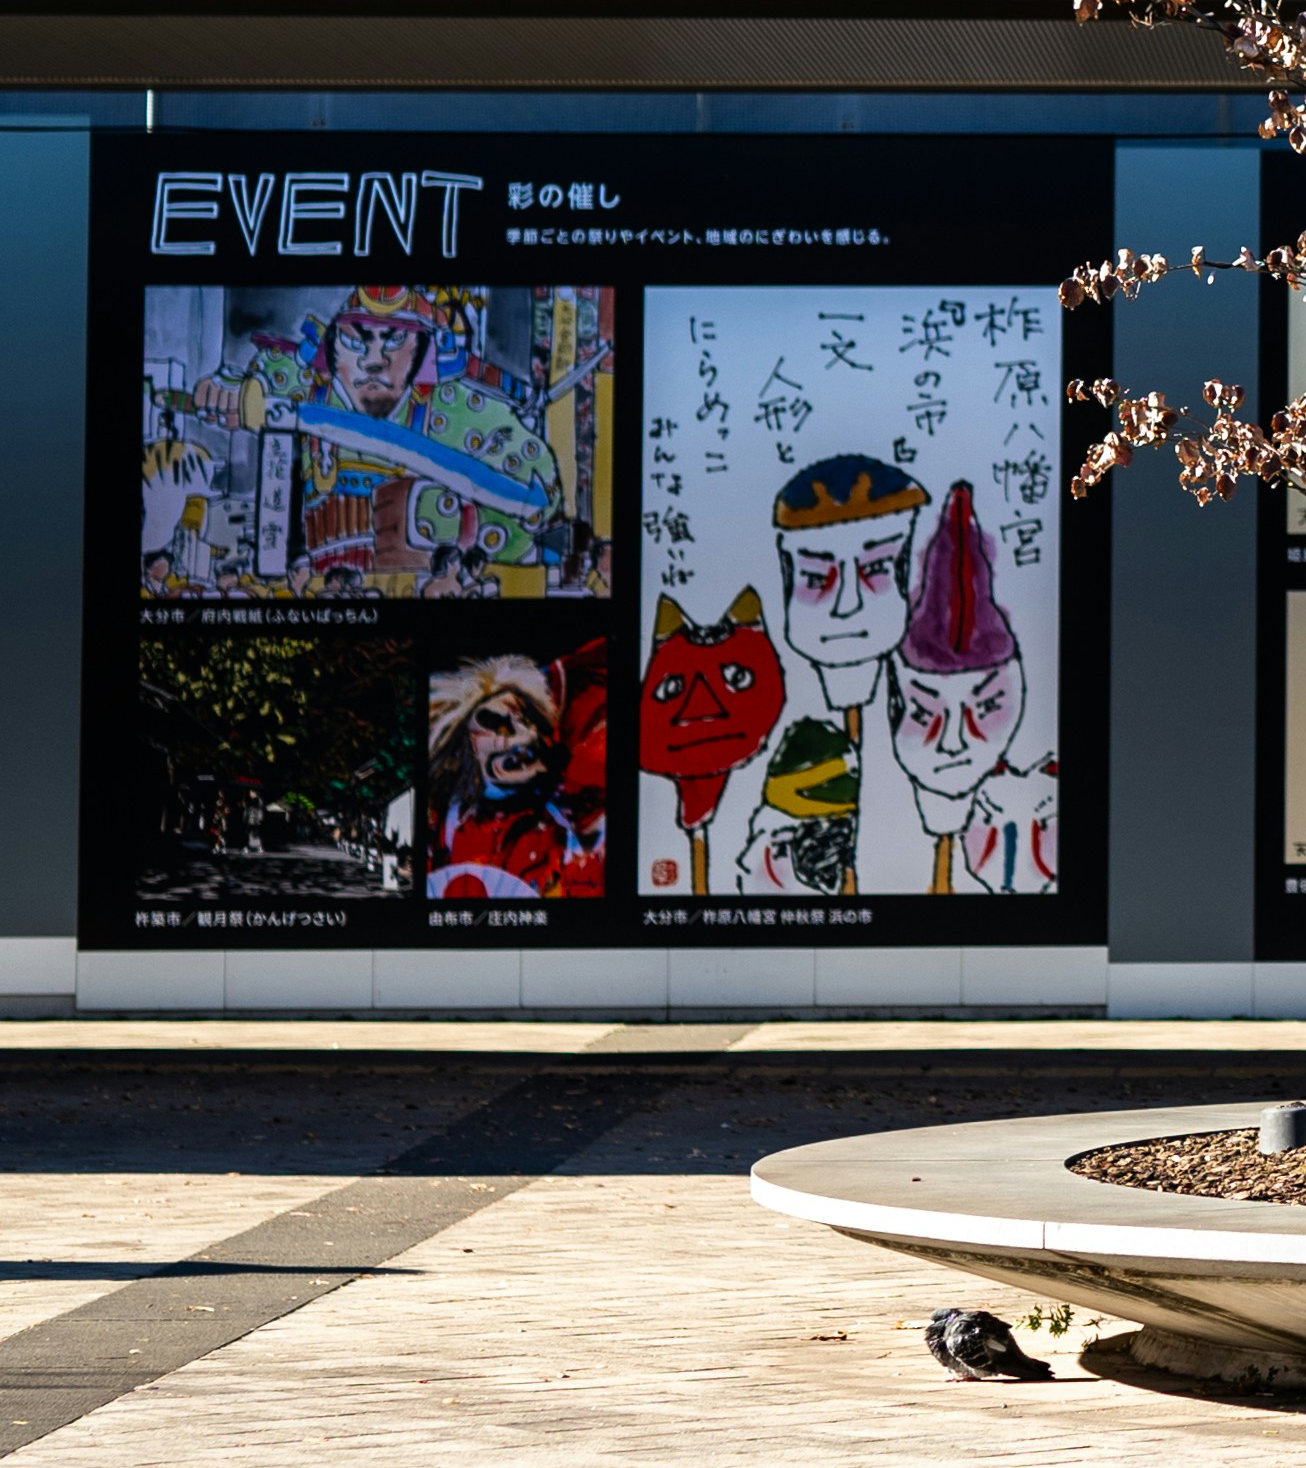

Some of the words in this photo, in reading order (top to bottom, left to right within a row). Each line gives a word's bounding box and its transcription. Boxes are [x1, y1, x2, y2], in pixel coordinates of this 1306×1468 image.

[151, 170, 483, 258] EVENT
[507, 181, 621, 211] 彩の催し
